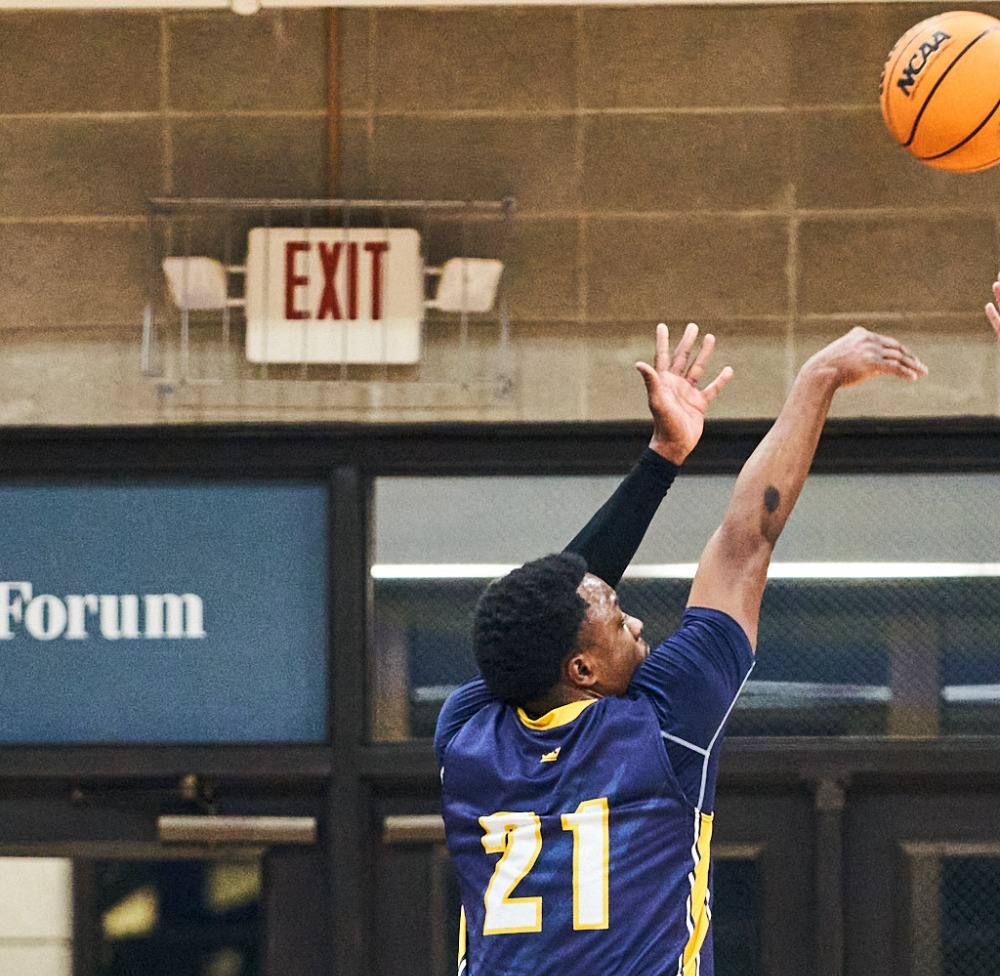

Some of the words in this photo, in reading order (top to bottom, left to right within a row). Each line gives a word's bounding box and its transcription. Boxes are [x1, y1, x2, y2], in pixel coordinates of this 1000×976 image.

[897, 30, 951, 97] NCAA
[284, 240, 390, 321] EXIT
[0, 581, 207, 640] Forum
[478, 797, 609, 935] 21
